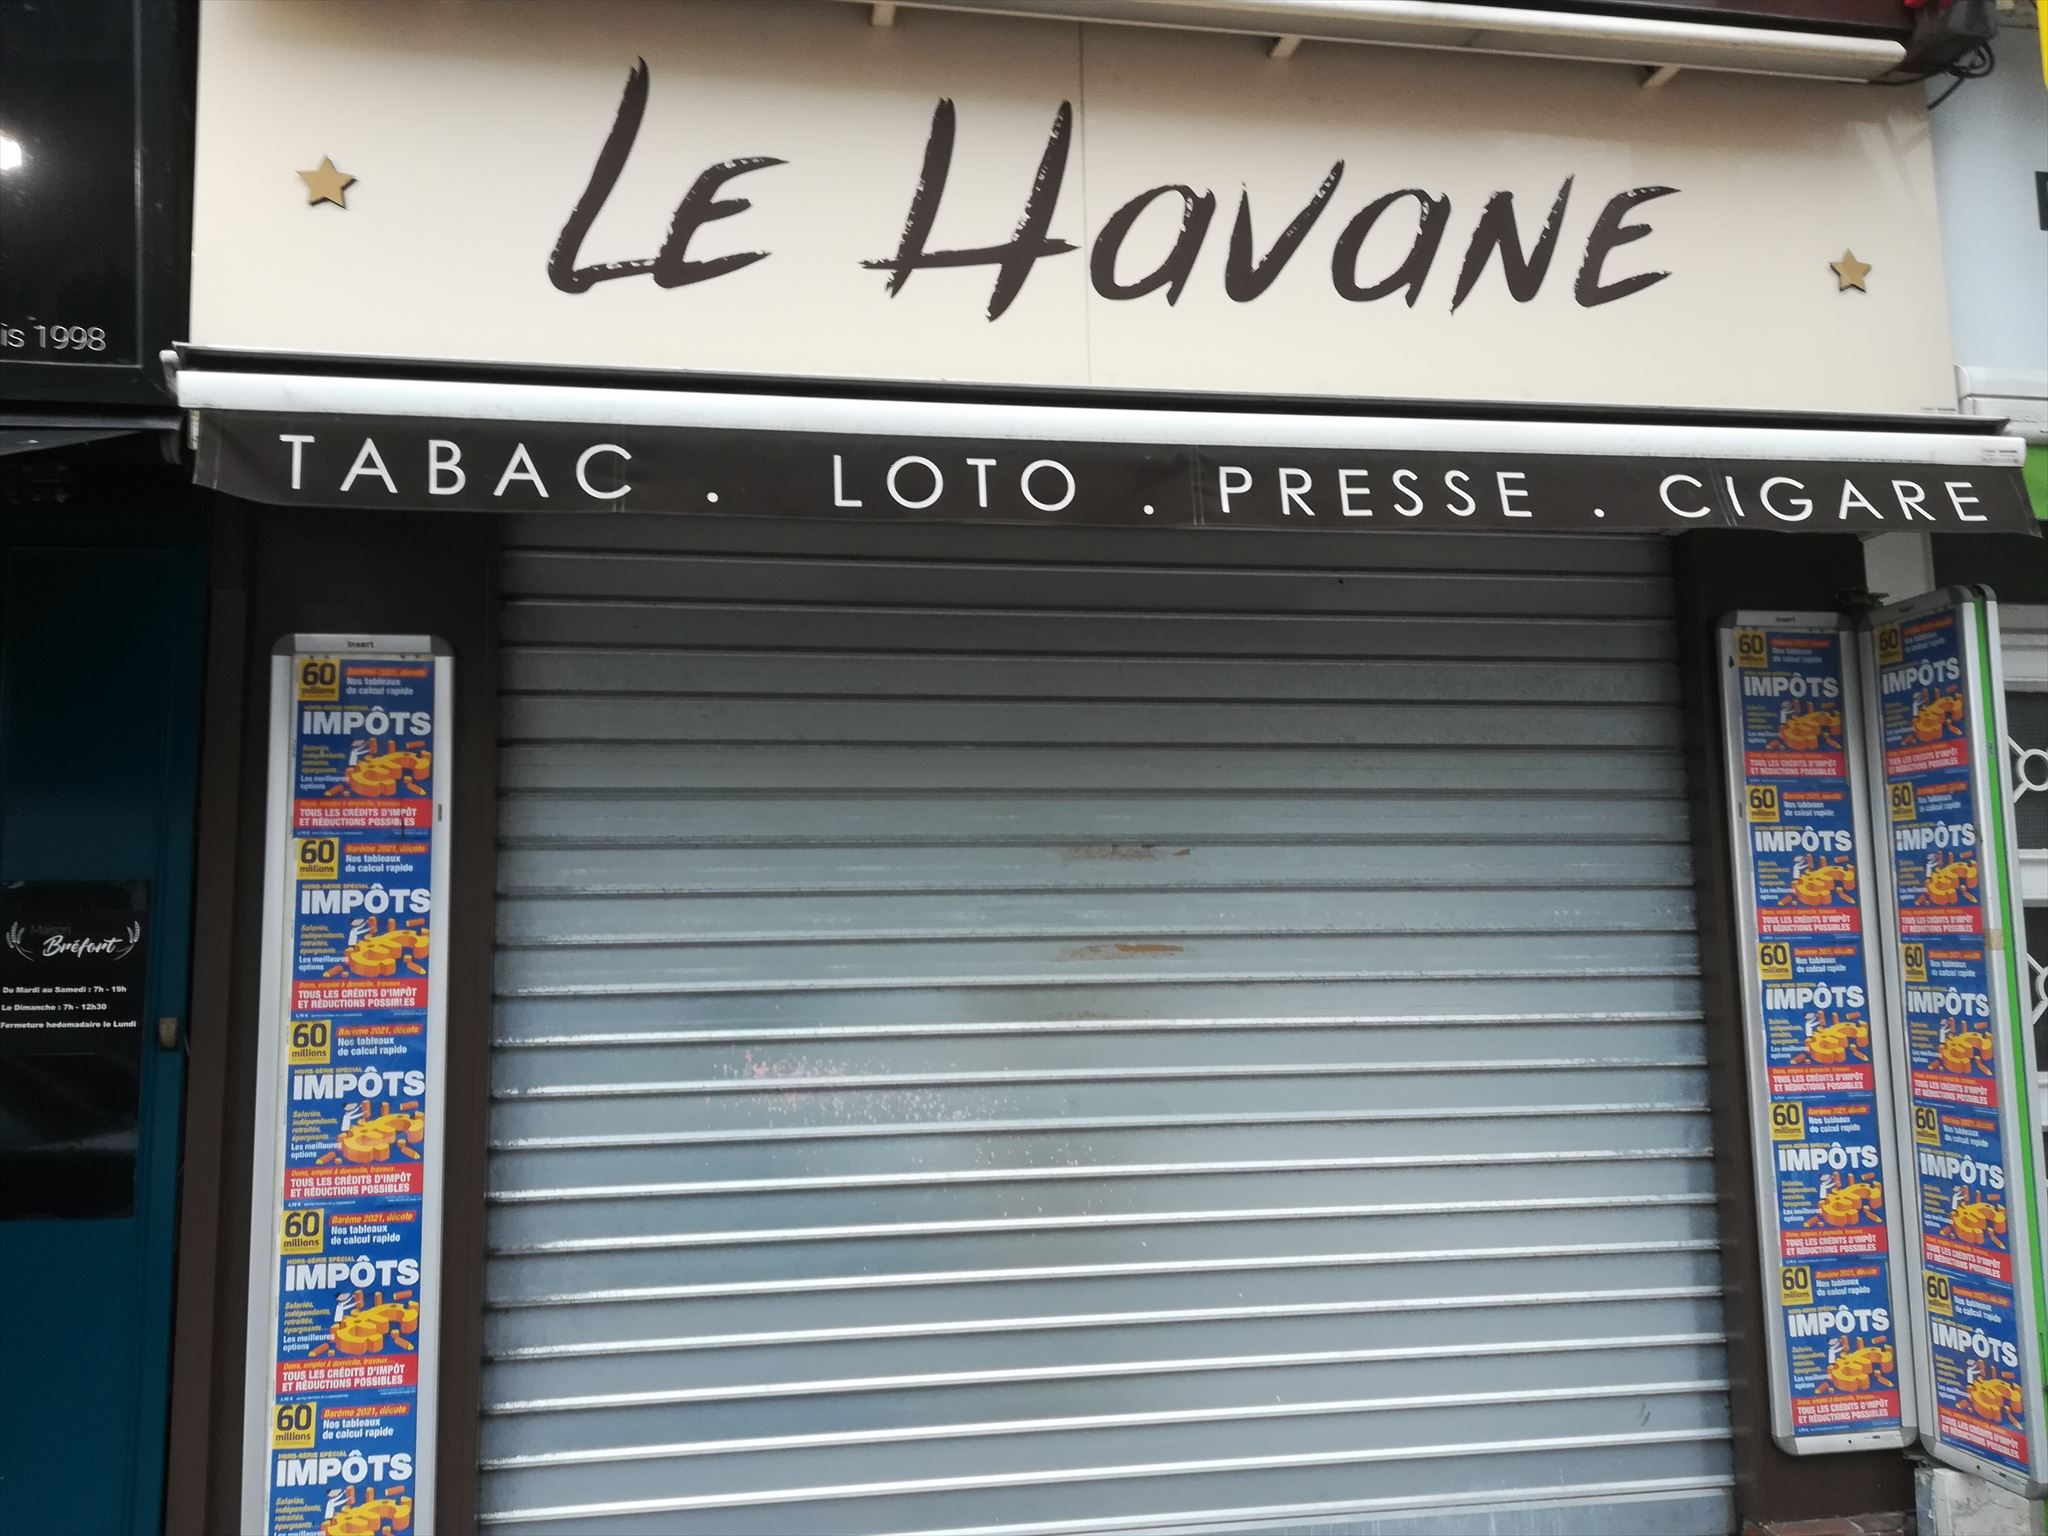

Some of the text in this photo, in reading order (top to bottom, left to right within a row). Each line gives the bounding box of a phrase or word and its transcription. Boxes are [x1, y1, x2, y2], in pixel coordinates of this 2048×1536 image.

[34, 325, 106, 351] 1998
[279, 434, 632, 500] TABAC
[833, 454, 1076, 512] LOTO
[1218, 466, 1533, 518] PRESSE
[1659, 474, 1989, 522] CIGARE
[1738, 635, 1764, 655] 60
[1880, 628, 1897, 648] 60
[302, 662, 335, 686] 60
[1883, 657, 1959, 695] IMPÔTS
[1743, 671, 1839, 698] IMPÔTS
[303, 705, 431, 736] IMPÔTS
[1748, 789, 1775, 809] 60
[1892, 785, 1911, 807] 60
[368, 818, 415, 826] POSSIBES
[1754, 825, 1852, 852] IMPÔTS
[1896, 820, 1975, 852] IMPÔTS
[300, 840, 334, 864] 60
[346, 854, 401, 863] Nos tableaux
[300, 865, 334, 873] millions
[358, 864, 384, 872] calcul
[386, 863, 413, 873] rapide
[301, 883, 431, 914] IMPÔTS
[1760, 945, 1787, 966] 60
[1905, 946, 1924, 967] 60
[299, 964, 324, 972] options
[2, 986, 14, 994] Du
[93, 985, 104, 993] 7h
[299, 990, 321, 999] TOUS
[324, 990, 339, 998] LES
[341, 987, 378, 997] CRÉDITS
[1766, 982, 1865, 1010] IMPÔTS
[14, 1003, 56, 1011] Dimanche
[298, 998, 415, 1009] ET RÉDUCTIONS POSSIBLES
[1908, 987, 1990, 1017] IMPÔTS
[113, 1020, 137, 1028] Lundi
[293, 1023, 327, 1048] 60
[339, 1036, 394, 1046] Nos tableaux
[292, 1049, 326, 1058] millions
[338, 1045, 407, 1056] de calcul rapide
[293, 1066, 425, 1100] IMPÔTS
[1772, 1104, 1801, 1126] 60
[1915, 1108, 1935, 1130] 60
[291, 1151, 317, 1160] options
[292, 1143, 303, 1151] Les
[1779, 1142, 1880, 1172] IMPÔTS
[1921, 1152, 2004, 1189] IMPÔTS
[290, 1183, 409, 1198] ET RÉDUCTIONS POSSIBLES
[291, 1178, 313, 1188] TOUS
[316, 1177, 332, 1186] LES
[335, 1174, 371, 1185] CRÉDITS
[285, 1211, 319, 1238] 60
[331, 1224, 387, 1235] Nos tableaux
[284, 1238, 319, 1248] millions
[331, 1233, 400, 1245] de calcul rapide
[286, 1255, 419, 1291] IMPÔTS
[1780, 1268, 1808, 1291] 60
[1927, 1276, 1948, 1300] 60
[1787, 1305, 1889, 1337] IMPÔTS
[283, 1343, 309, 1352] options
[284, 1333, 335, 1343] Les meilleures
[1932, 1322, 2018, 1367] IMPÔTS
[282, 1375, 402, 1392] ET RÉDUCTIONS POSSIBLES
[283, 1371, 306, 1381] TOUS
[309, 1370, 325, 1379] LES
[327, 1367, 364, 1378] CRÉDITS
[277, 1404, 312, 1432] 60
[324, 1418, 380, 1429] Nos tableaux
[276, 1432, 311, 1442] millions
[323, 1426, 393, 1439] de calcul rapide
[276, 1449, 412, 1487] IMPÔTS
